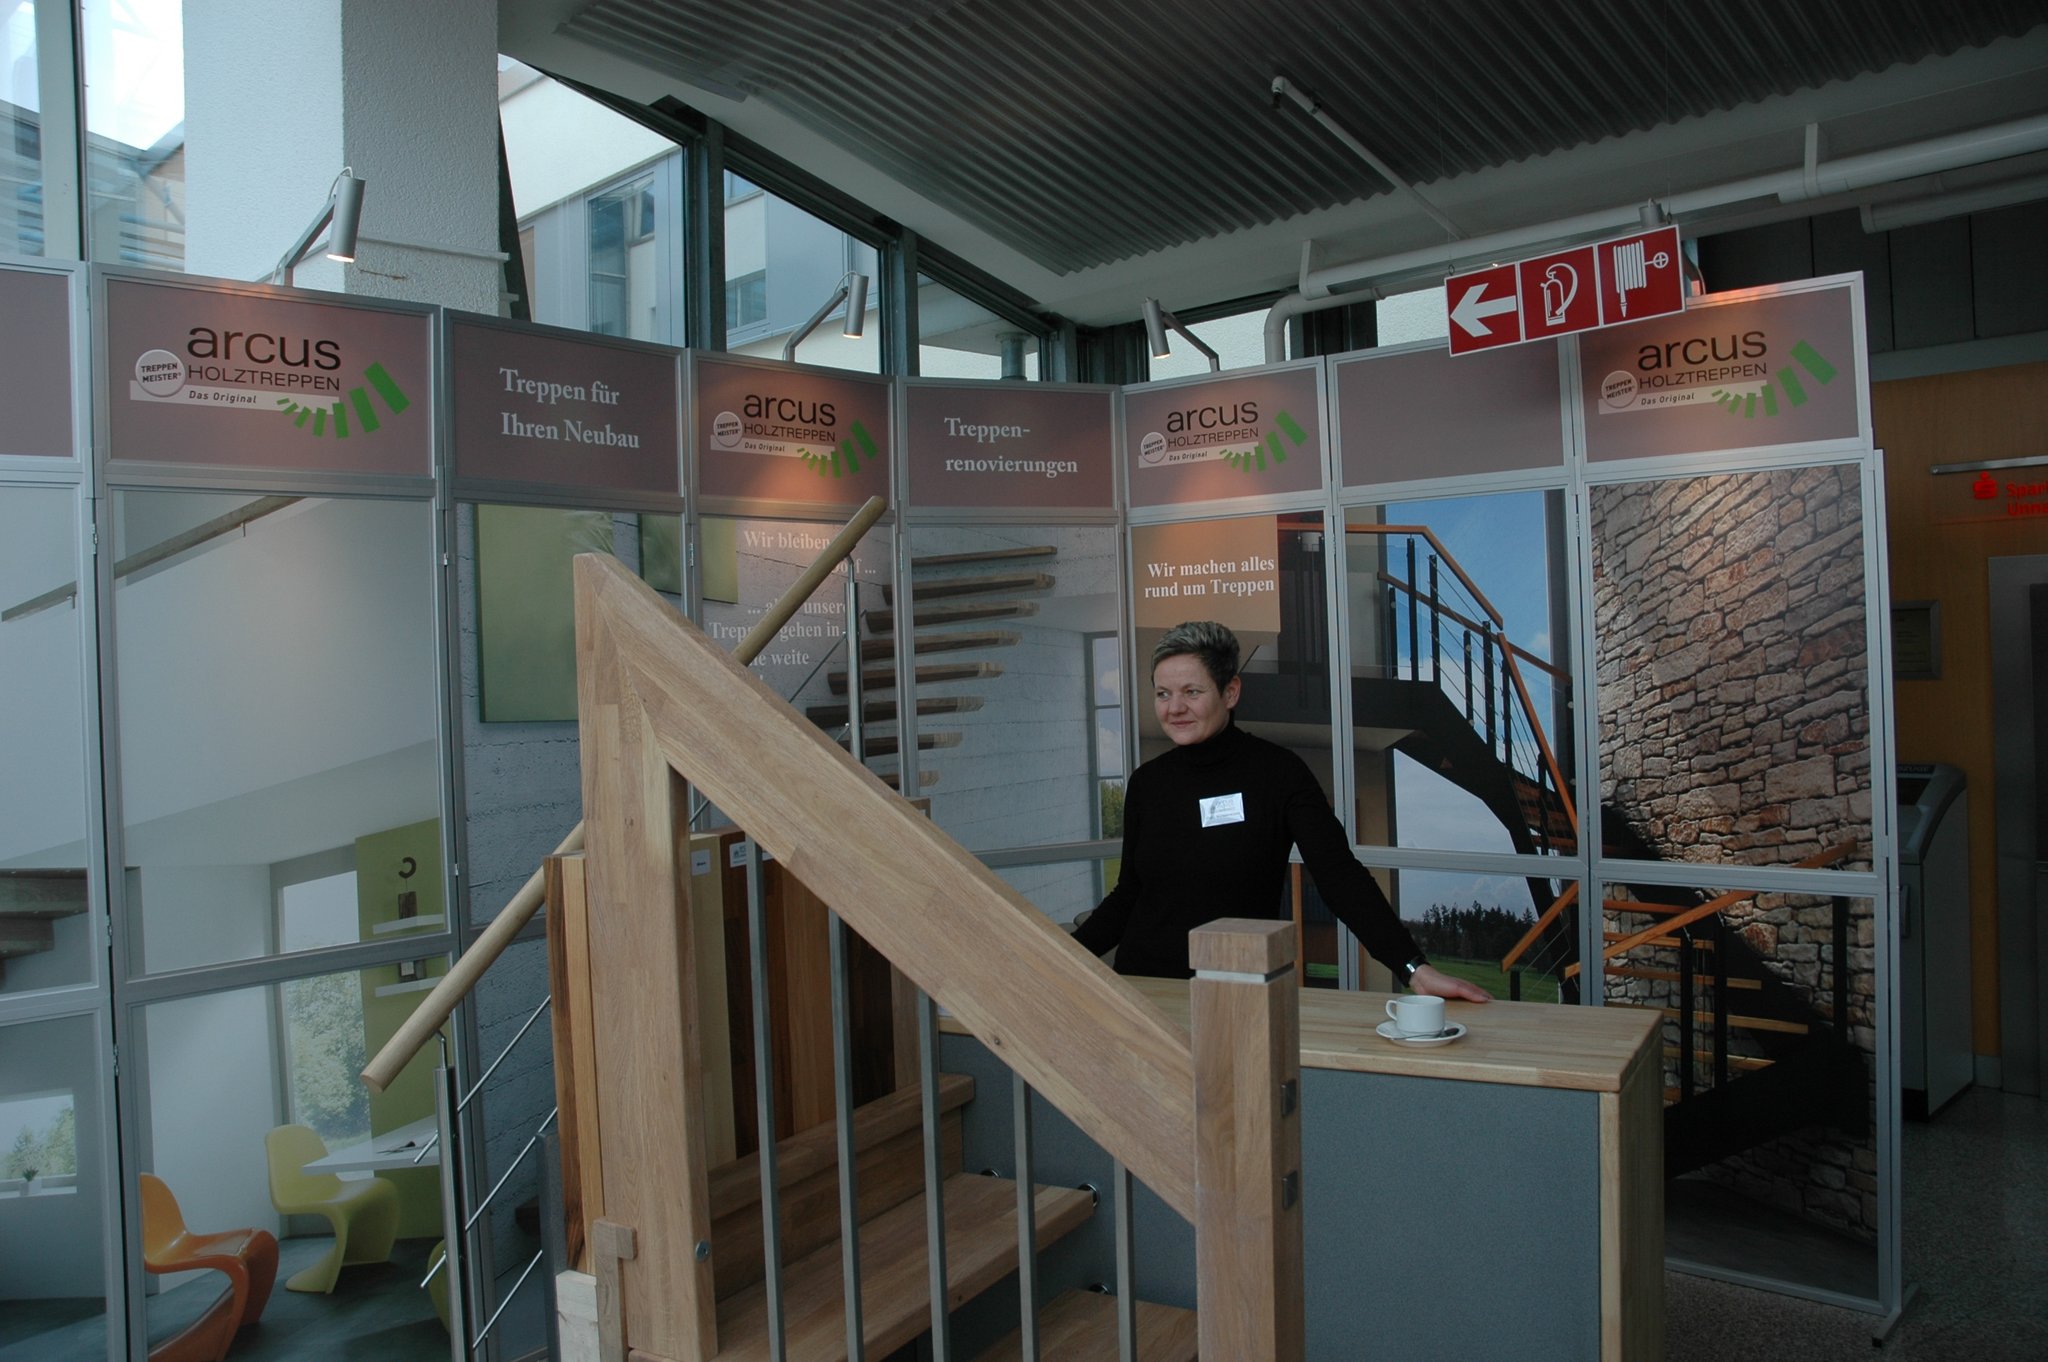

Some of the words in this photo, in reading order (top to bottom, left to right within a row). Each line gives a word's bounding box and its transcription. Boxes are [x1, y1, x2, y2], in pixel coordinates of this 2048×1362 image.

[187, 327, 341, 371] arcus
[1638, 331, 1767, 371] arcus
[141, 363, 178, 373] TREPPEN
[188, 365, 340, 391] HOLZTREPPEN
[1639, 362, 1767, 389] HOLZTREPPEN
[499, 367, 585, 405] Treppen
[591, 380, 619, 405] für
[1605, 379, 1632, 393] TREPPEN
[189, 390, 209, 400] Das
[213, 392, 257, 404] Original
[1641, 397, 1656, 405] Das
[1660, 393, 1695, 404] Original
[743, 394, 836, 426] arcus
[1167, 402, 1258, 433] arcus
[501, 412, 559, 440] Ihren
[563, 419, 640, 448] Neubau
[744, 423, 835, 442] HOLZTREPPEN
[944, 417, 1030, 443] Treppen-
[1168, 428, 1258, 448] HOLZTREPPEN
[760, 443, 785, 452] Original
[1182, 451, 1207, 460] Original
[945, 455, 1078, 478] renovierungen
[743, 530, 774, 548] Wir
[778, 532, 831, 550] bleiben
[1147, 562, 1176, 578] Wir
[1180, 559, 1236, 576] machen
[1241, 556, 1275, 572] alles
[1145, 581, 1178, 598] rund
[1183, 583, 1206, 596] um
[1210, 579, 1275, 597] Treppen
[780, 621, 822, 642] gehen
[827, 622, 840, 638] in
[770, 649, 809, 665] weite
